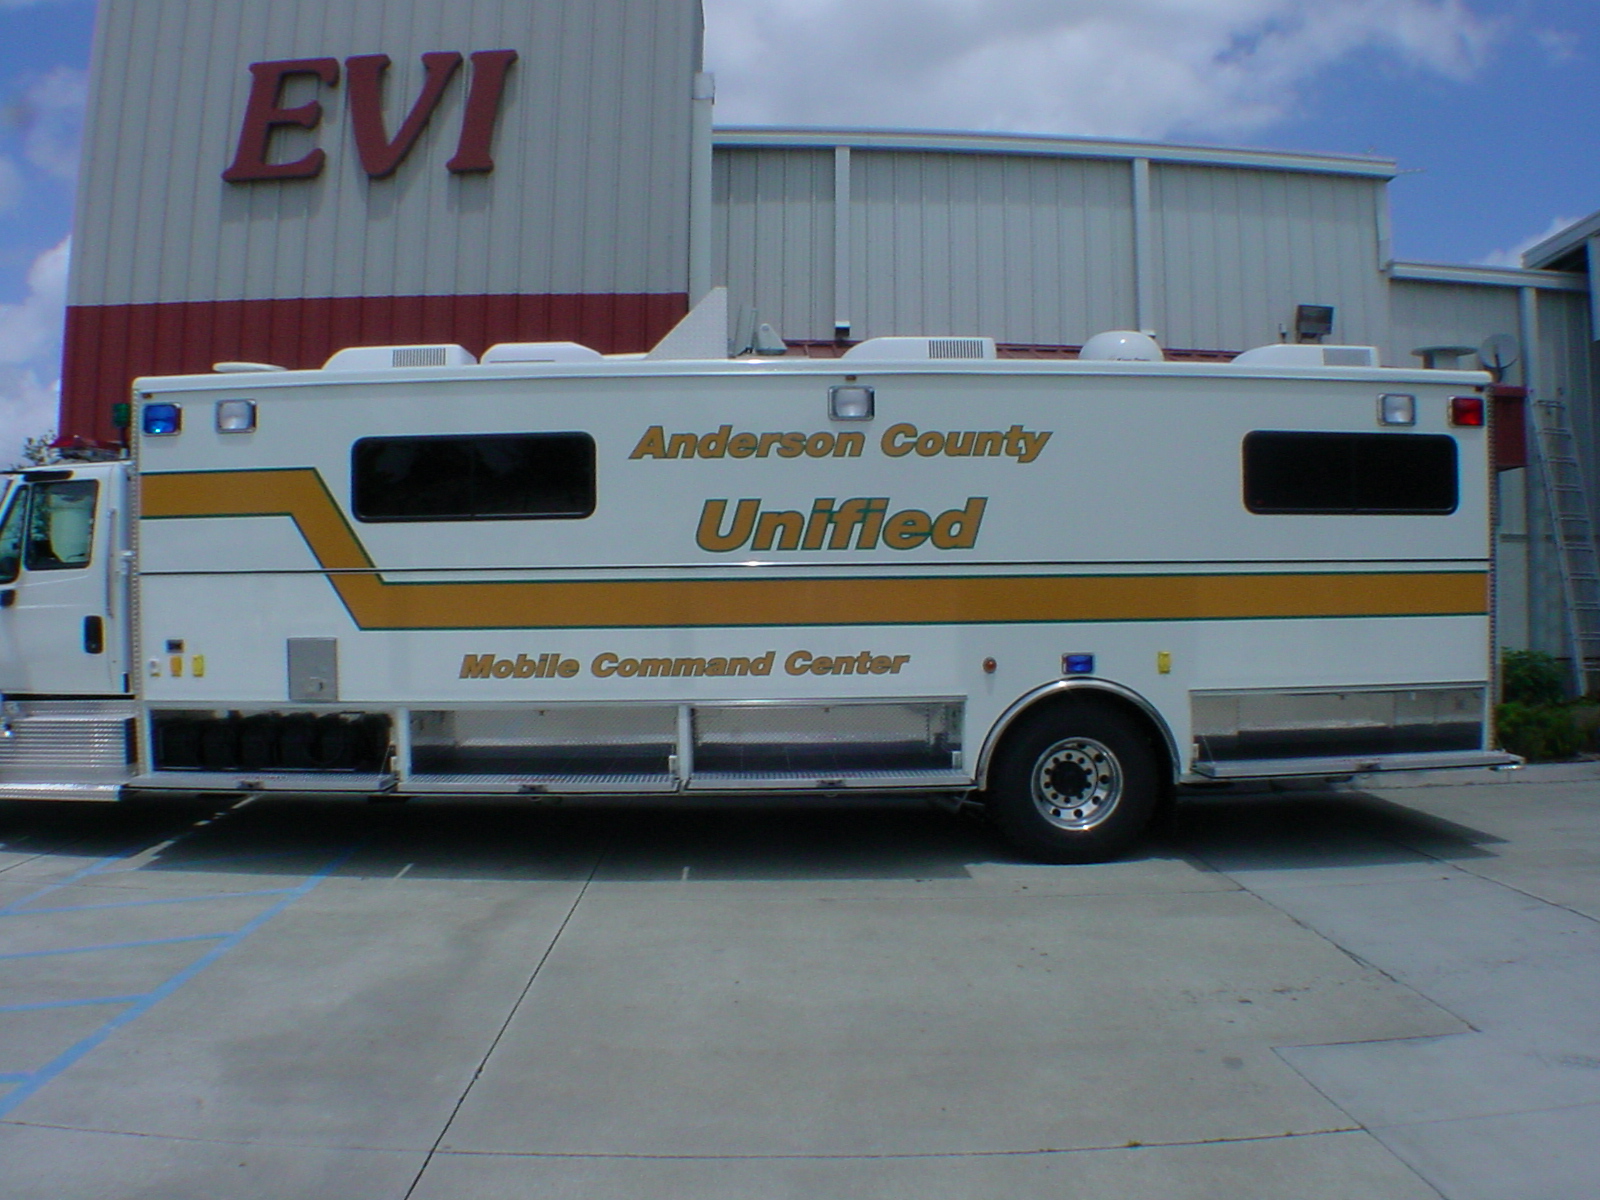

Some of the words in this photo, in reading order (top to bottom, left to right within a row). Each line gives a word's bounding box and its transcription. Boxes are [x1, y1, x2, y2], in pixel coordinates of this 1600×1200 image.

[222, 49, 518, 183] EVI
[628, 424, 866, 460] Anderson
[880, 423, 1054, 463] County
[696, 496, 989, 552] Unified
[458, 653, 580, 679] Mobile
[591, 651, 776, 678] Command
[784, 650, 911, 676] Center
